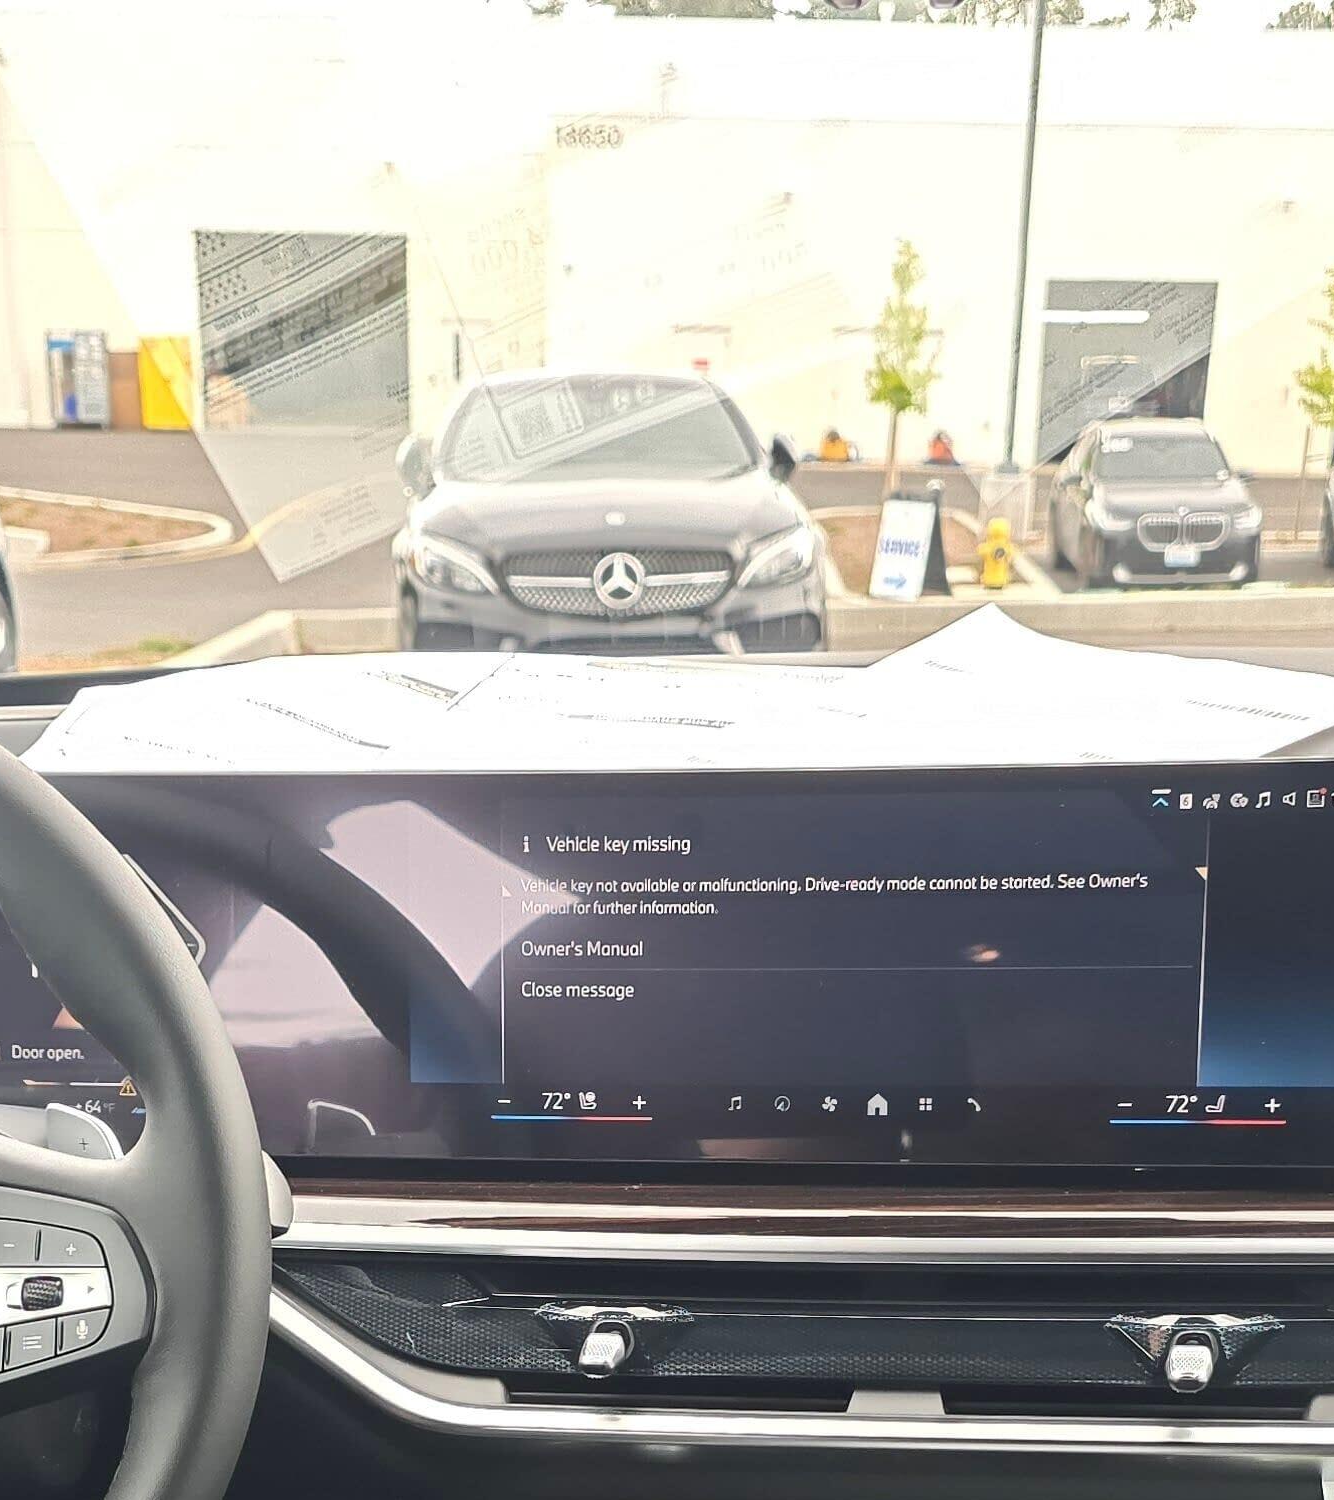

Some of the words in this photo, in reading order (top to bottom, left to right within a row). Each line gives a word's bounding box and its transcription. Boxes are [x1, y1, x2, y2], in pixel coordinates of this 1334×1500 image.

[546, 836, 599, 853] Vehicle
[603, 836, 629, 855] key
[633, 837, 691, 855] missing
[520, 878, 567, 892] Vehicle
[571, 879, 593, 895] key
[596, 880, 618, 892] not
[621, 878, 679, 893] available
[682, 882, 696, 892] or
[699, 877, 802, 895] malfunctioning.
[805, 877, 884, 894] Drive-ready
[886, 876, 926, 891] mode
[929, 877, 977, 891] cannot
[981, 875, 998, 890] be
[1001, 874, 1055, 890] started.
[1058, 873, 1085, 889] See
[1089, 873, 1149, 889] Owner's
[521, 900, 570, 915] Manual
[573, 900, 591, 915] for
[593, 900, 637, 915] further
[639, 899, 719, 915] information.
[521, 941, 583, 957] Owner's
[587, 941, 644, 957] Manual
[521, 981, 562, 998] Close
[566, 984, 635, 1001] message
[11, 1044, 44, 1060] Door
[46, 1047, 85, 1062] open.
